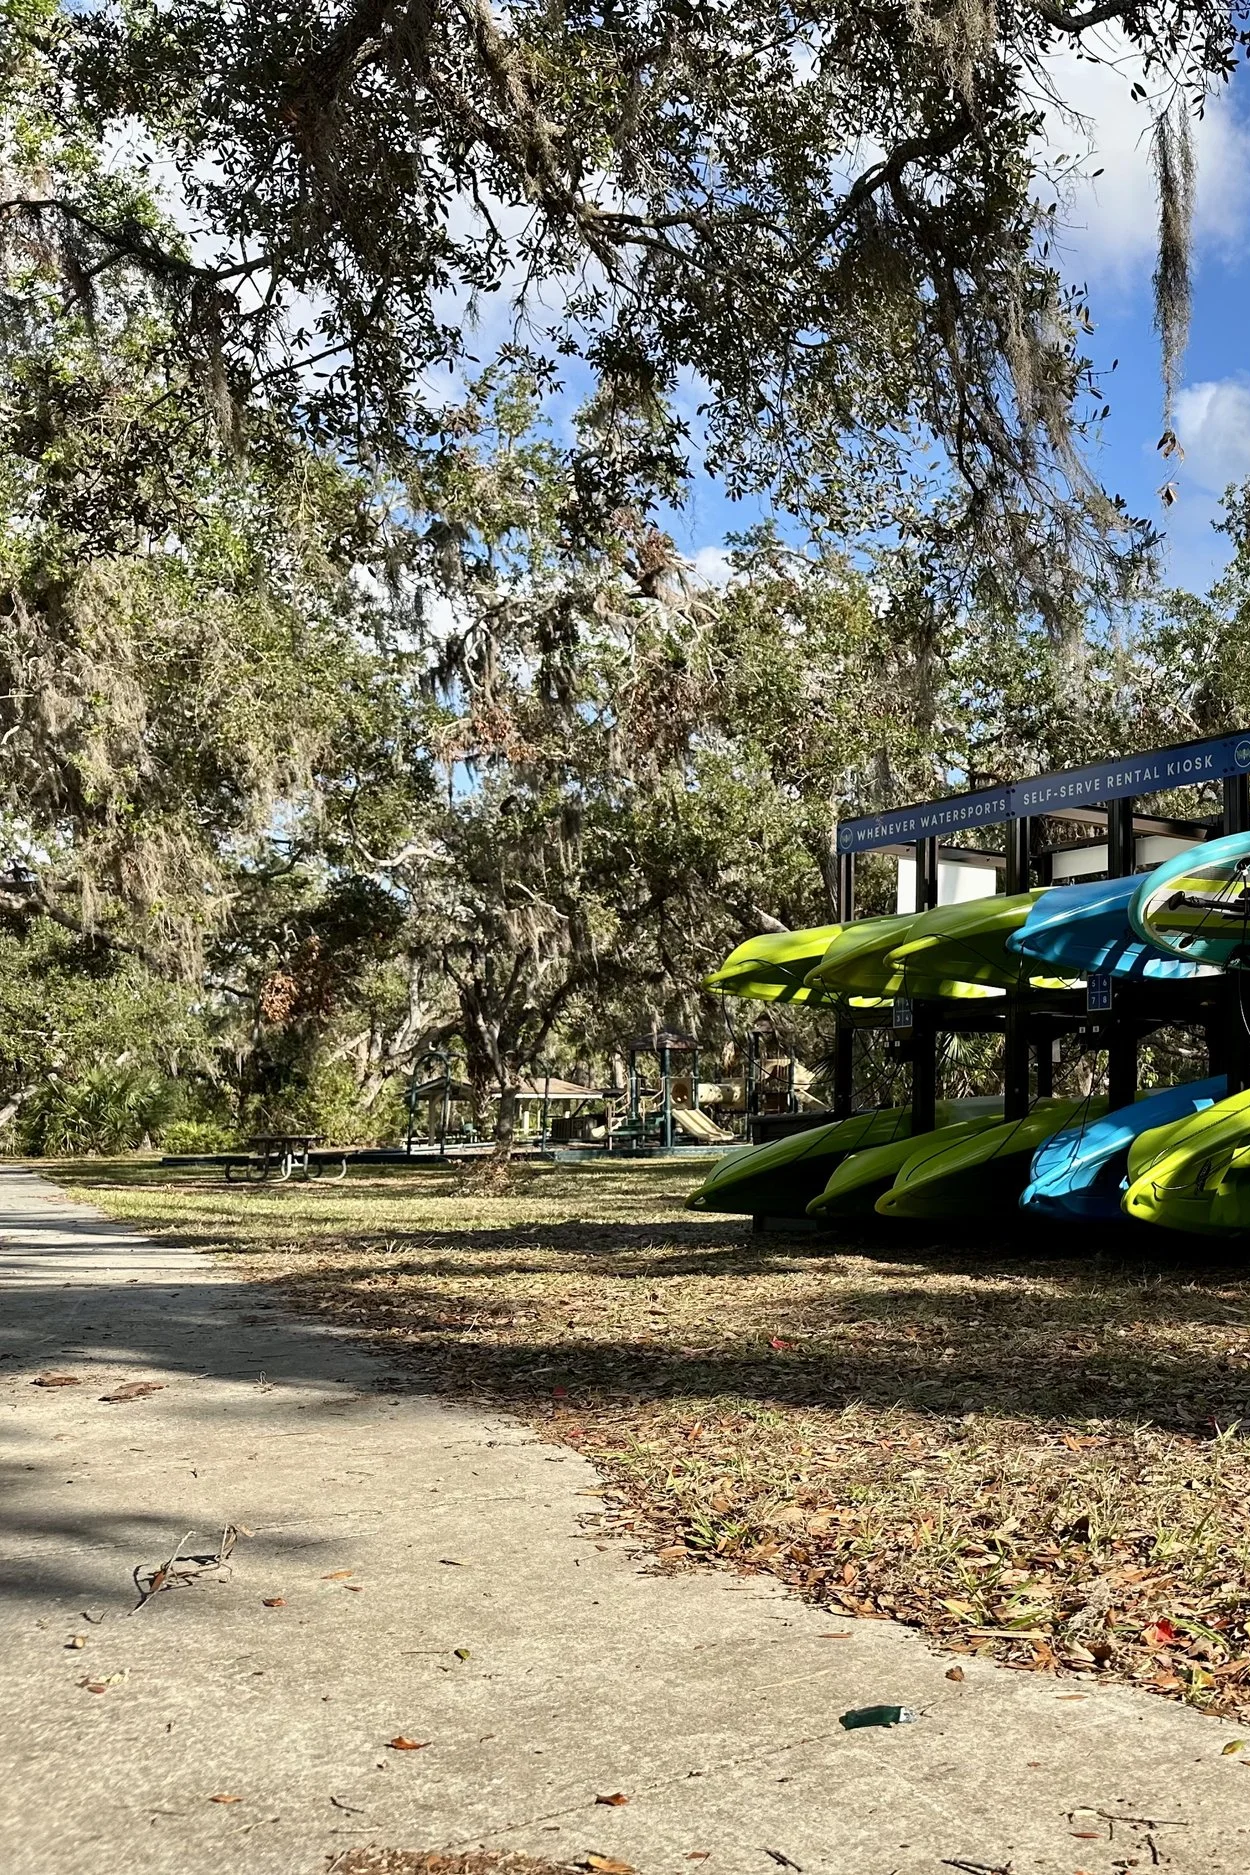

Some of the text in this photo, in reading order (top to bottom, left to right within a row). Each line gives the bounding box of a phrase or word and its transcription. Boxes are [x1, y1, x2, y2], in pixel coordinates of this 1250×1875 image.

[1023, 777, 1101, 806] SELF-SERVE
[1107, 767, 1160, 789] RENTAL
[1166, 754, 1214, 775] KIOSK
[856, 799, 1006, 842] WHENEVER WATERSPORTS
[1091, 979, 1107, 987] 5 6
[1091, 995, 1107, 1005] 7 8
